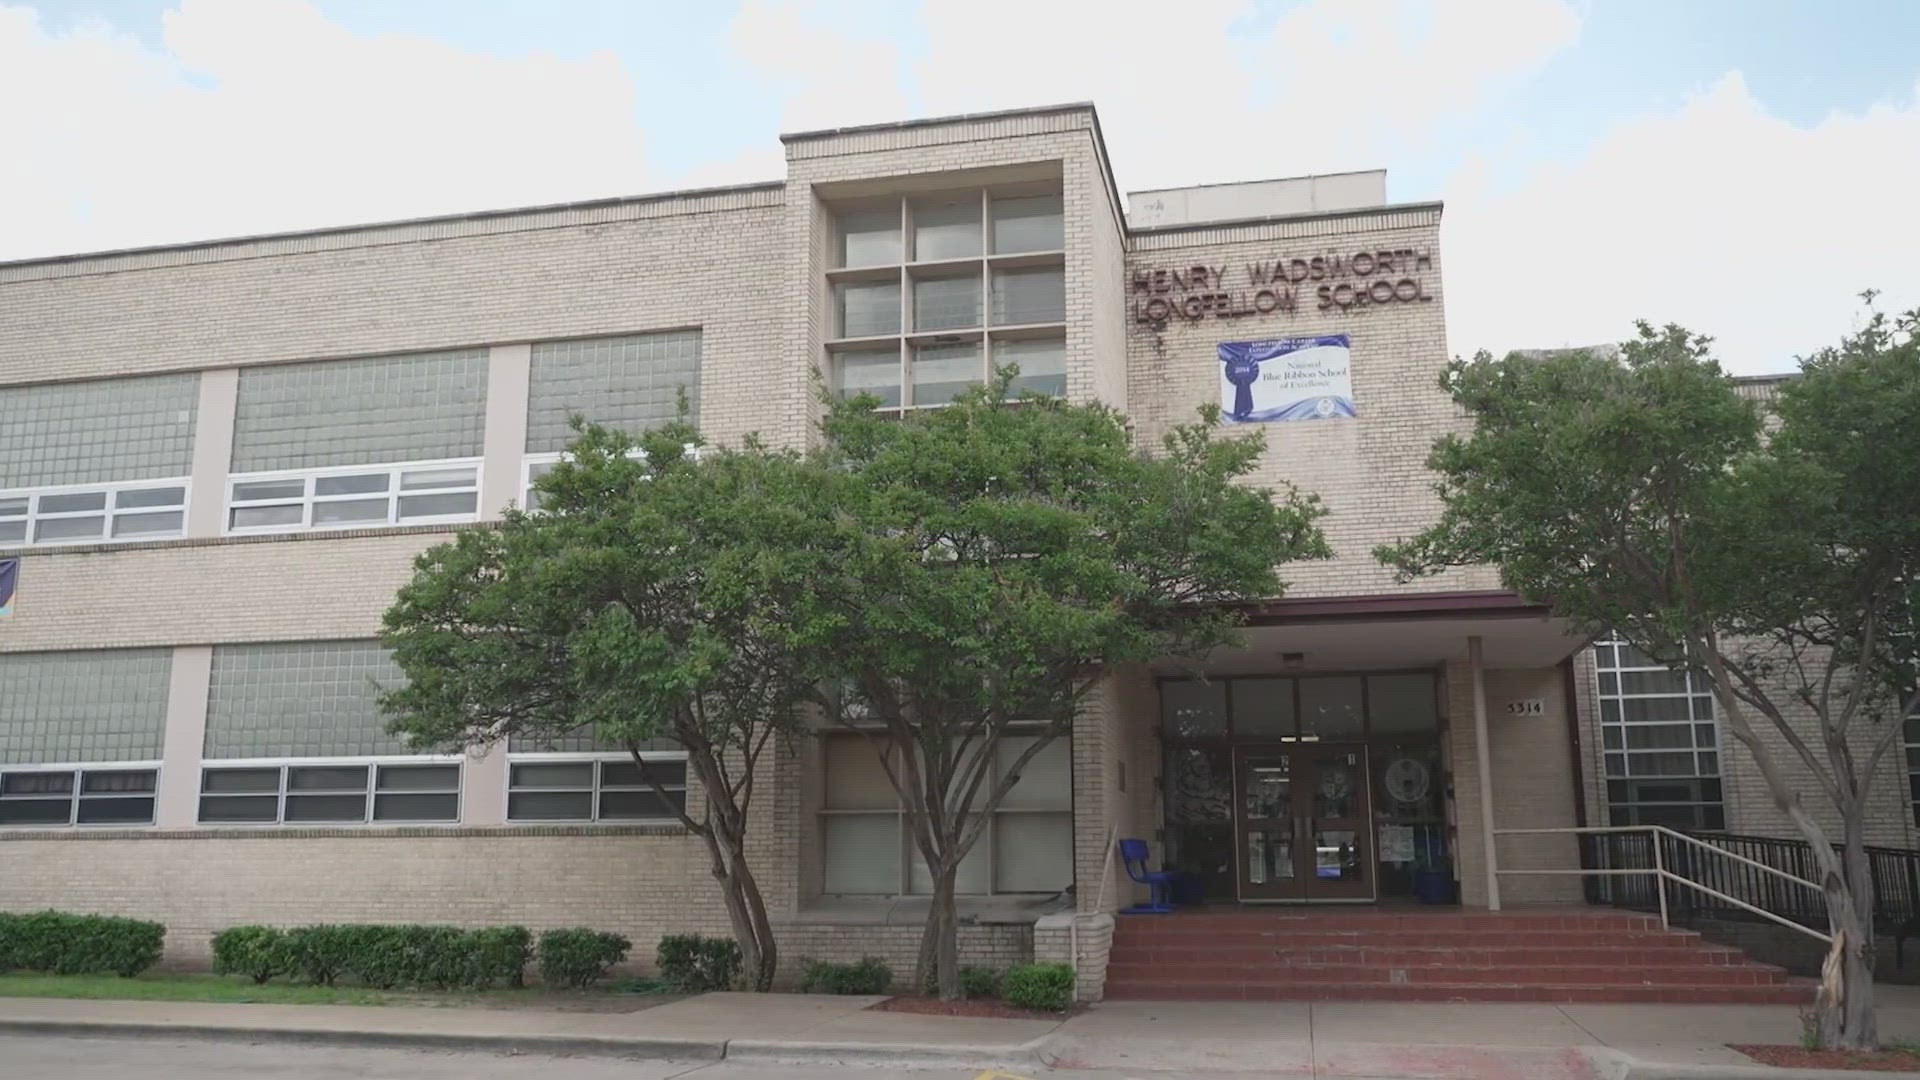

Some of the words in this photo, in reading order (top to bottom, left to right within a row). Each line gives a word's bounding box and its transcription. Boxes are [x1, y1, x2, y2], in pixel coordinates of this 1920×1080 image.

[1132, 265, 1227, 294] HENRY
[1246, 247, 1432, 286] WADSWORTH
[1135, 287, 1298, 324] LONGFELLOW
[1317, 278, 1432, 310] SCHOOL
[1263, 372, 1280, 381] Blue
[1284, 370, 1317, 380] Ribbon
[1318, 367, 1346, 377] School
